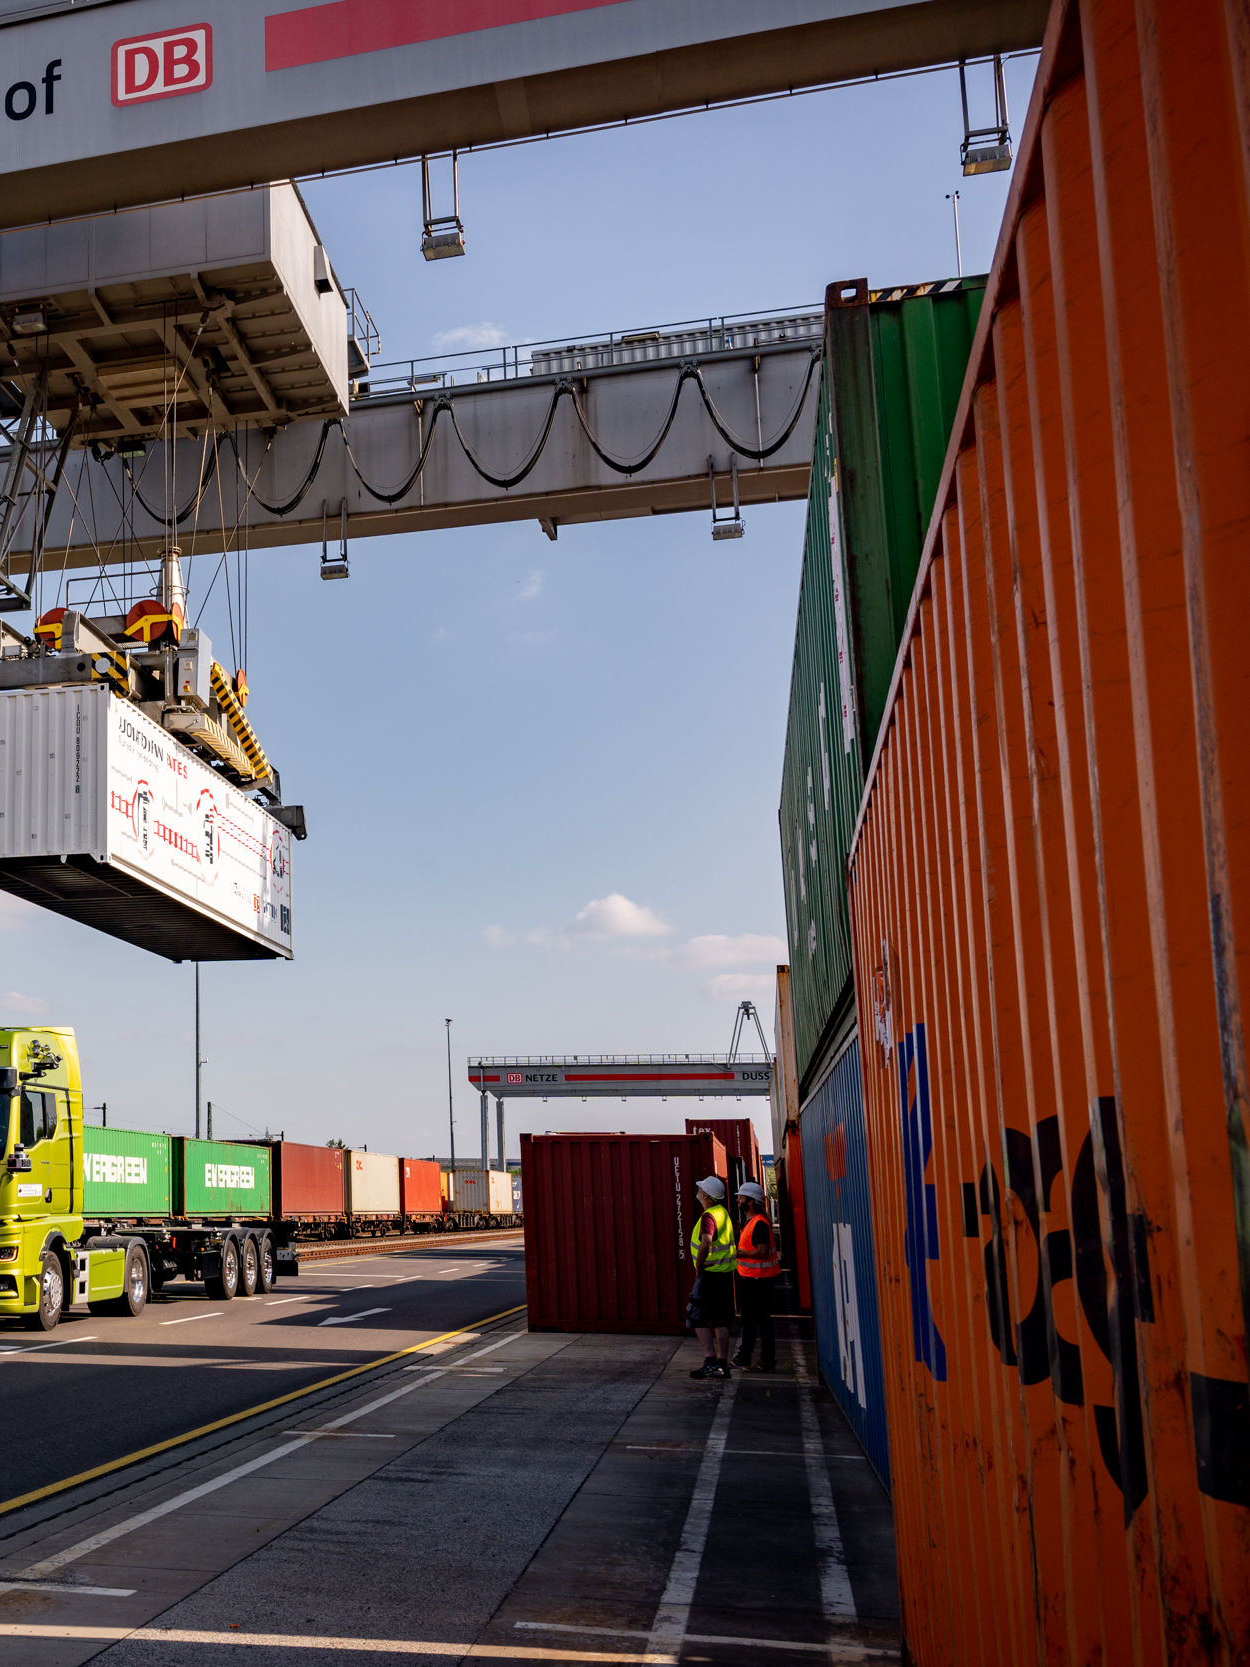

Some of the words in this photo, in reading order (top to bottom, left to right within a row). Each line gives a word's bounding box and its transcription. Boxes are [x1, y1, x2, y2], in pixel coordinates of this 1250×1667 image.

[125, 38, 200, 93] DB
[508, 1073, 522, 1083] DB
[525, 1073, 558, 1083] NETZE
[742, 1072, 770, 1080] DUSS
[83, 1153, 148, 1184] VERGREEN
[205, 1163, 255, 1189] EVERGREEN
[676, 1194, 684, 1247] 272158
